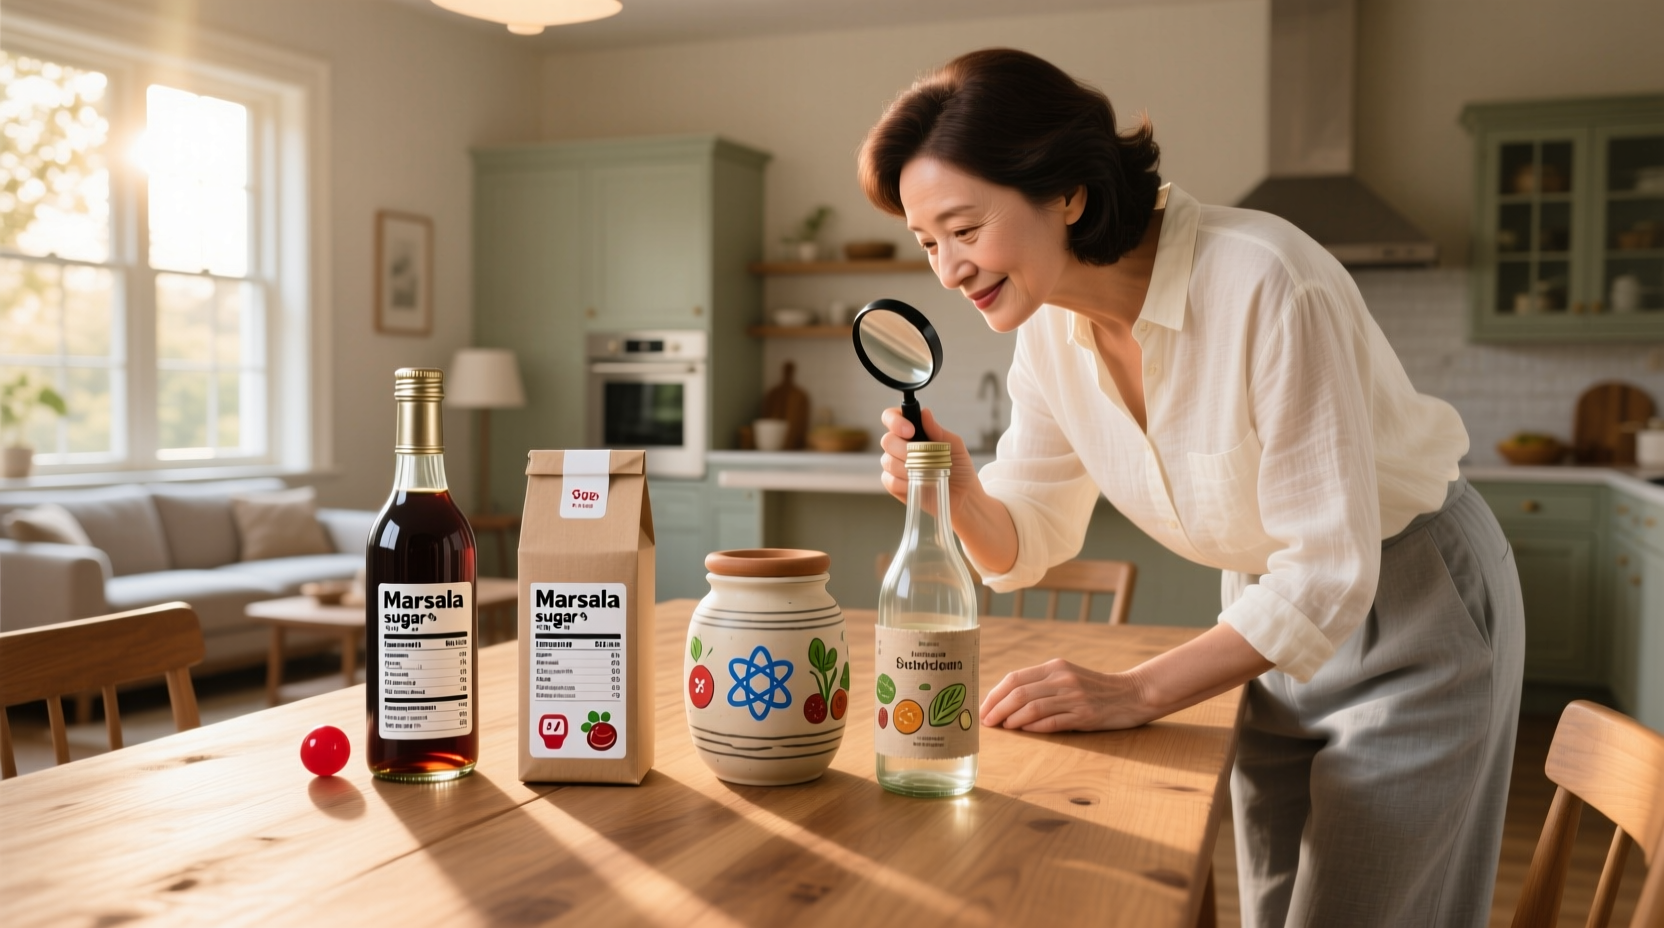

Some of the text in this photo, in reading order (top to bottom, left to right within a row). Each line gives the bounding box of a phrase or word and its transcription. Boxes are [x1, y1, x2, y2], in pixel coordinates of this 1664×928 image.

[384, 590, 464, 609] Marsala
[536, 589, 620, 609] Marsala
[384, 613, 427, 629] sugar
[535, 612, 578, 629] sugar
